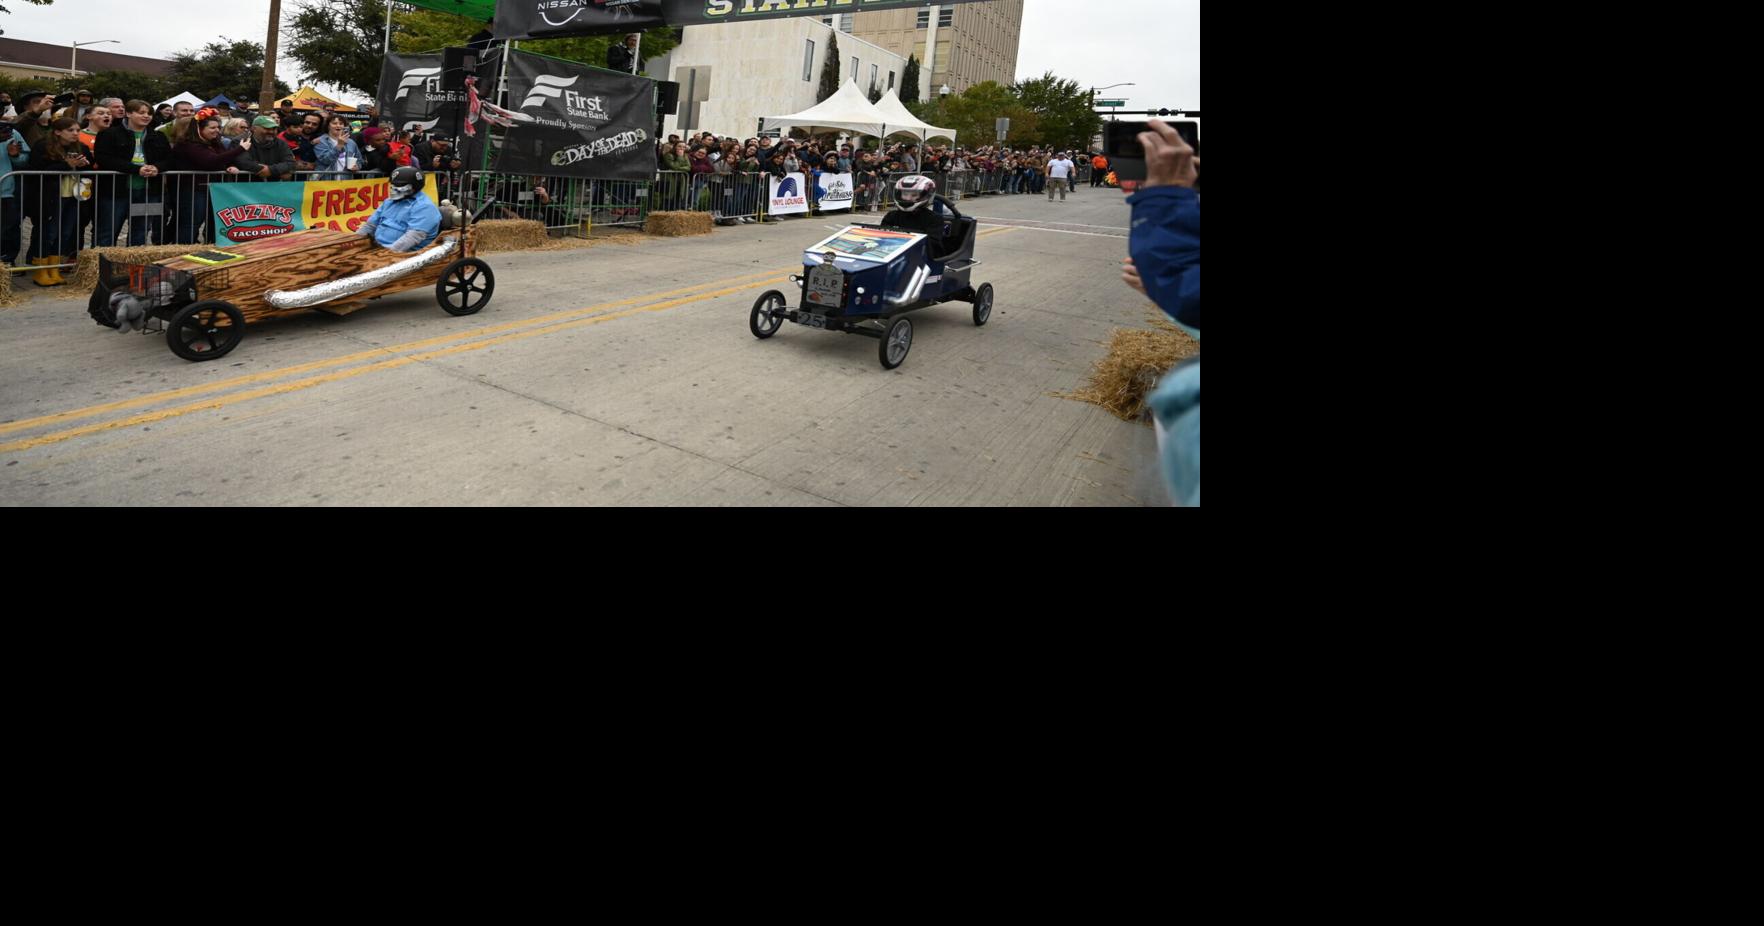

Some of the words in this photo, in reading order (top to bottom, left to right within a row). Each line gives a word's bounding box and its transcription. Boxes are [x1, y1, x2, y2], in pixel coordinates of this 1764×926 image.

[537, 0, 587, 10] NISSAN
[425, 93, 446, 102] State
[564, 89, 603, 112] First
[566, 106, 588, 118] State
[588, 111, 609, 121] Bank
[535, 116, 567, 130] Proudly
[565, 140, 595, 165] DAY
[605, 130, 637, 153] DEAD
[311, 182, 389, 218] FRESH
[217, 204, 296, 227] FUZZY'S
[232, 230, 259, 238] TACO
[260, 228, 288, 236] SHOP
